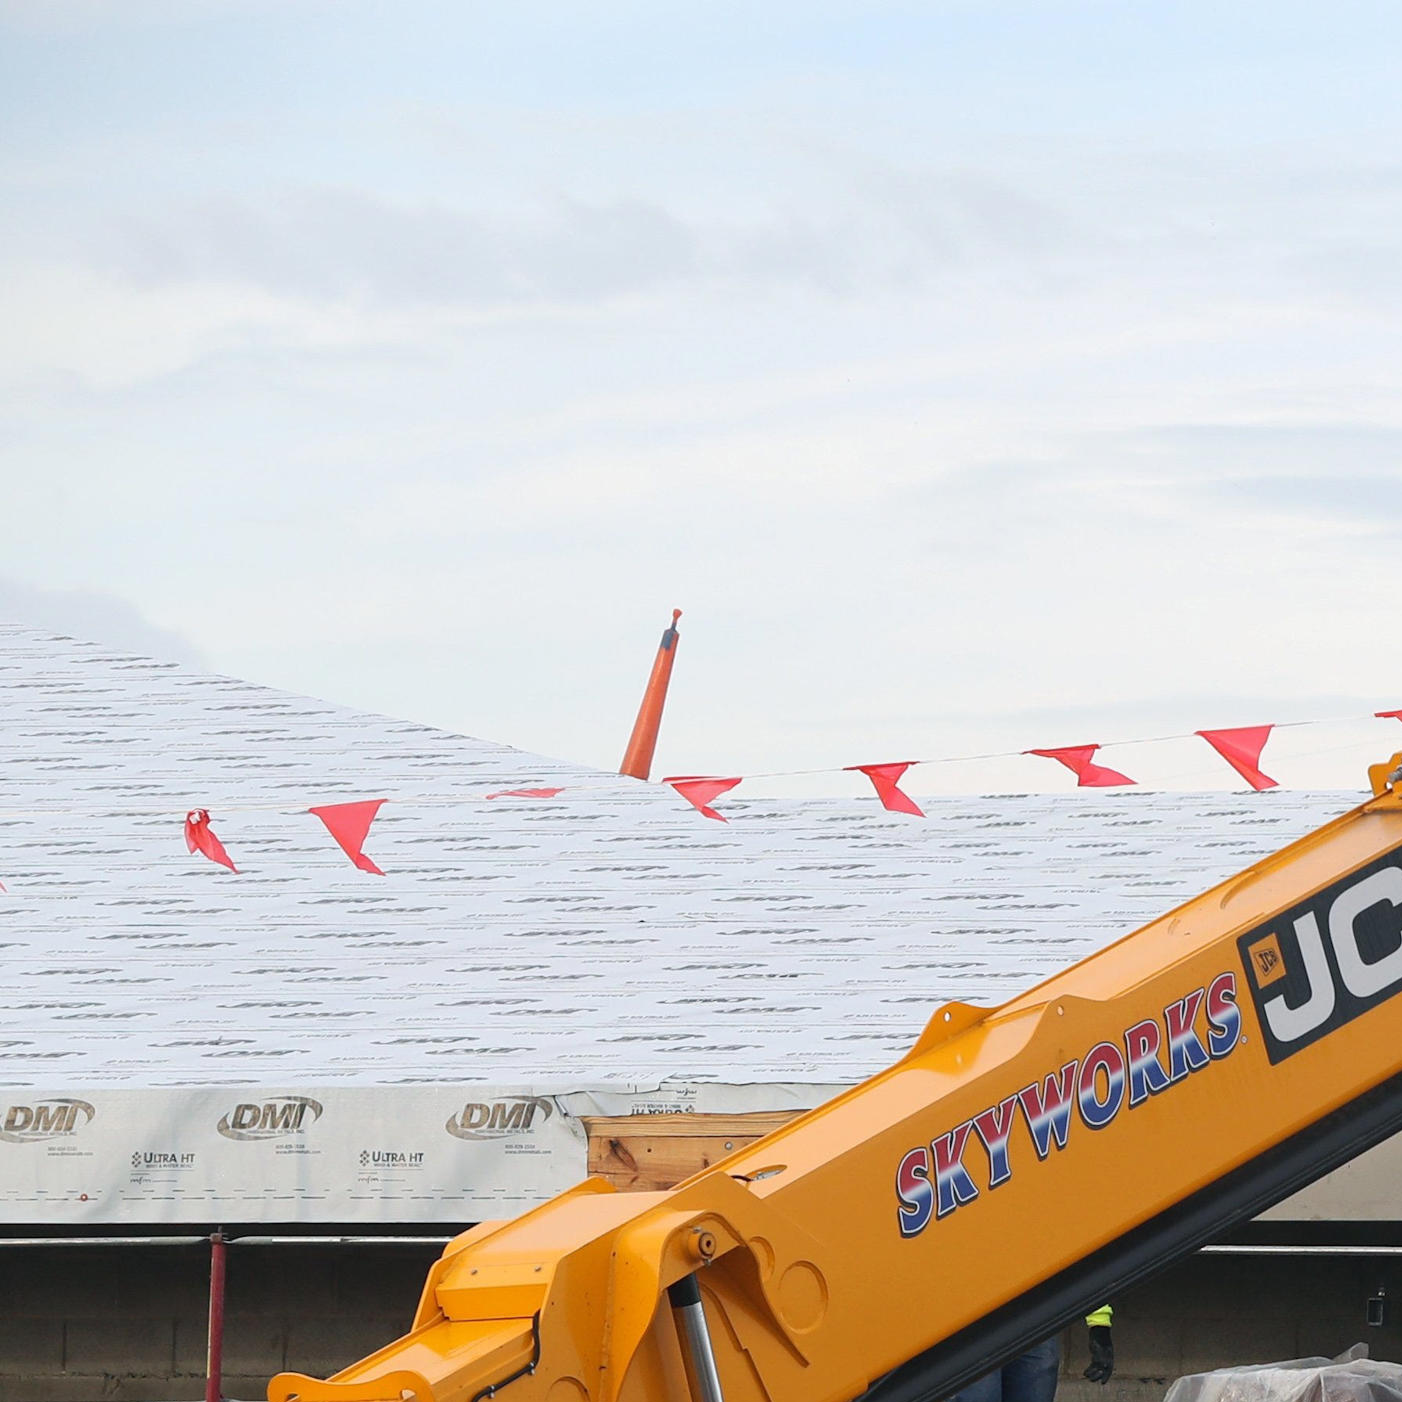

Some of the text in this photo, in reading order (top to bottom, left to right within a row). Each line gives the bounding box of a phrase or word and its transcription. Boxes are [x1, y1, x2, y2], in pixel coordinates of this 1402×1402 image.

[231, 1103, 307, 1129] DMI
[461, 1103, 537, 1129] DMI
[895, 971, 1243, 1238] SKYWORKS
[4, 1105, 78, 1132] DMI
[144, 1152, 195, 1163] ULTRA HT
[372, 1150, 424, 1162] ULTRA HT
